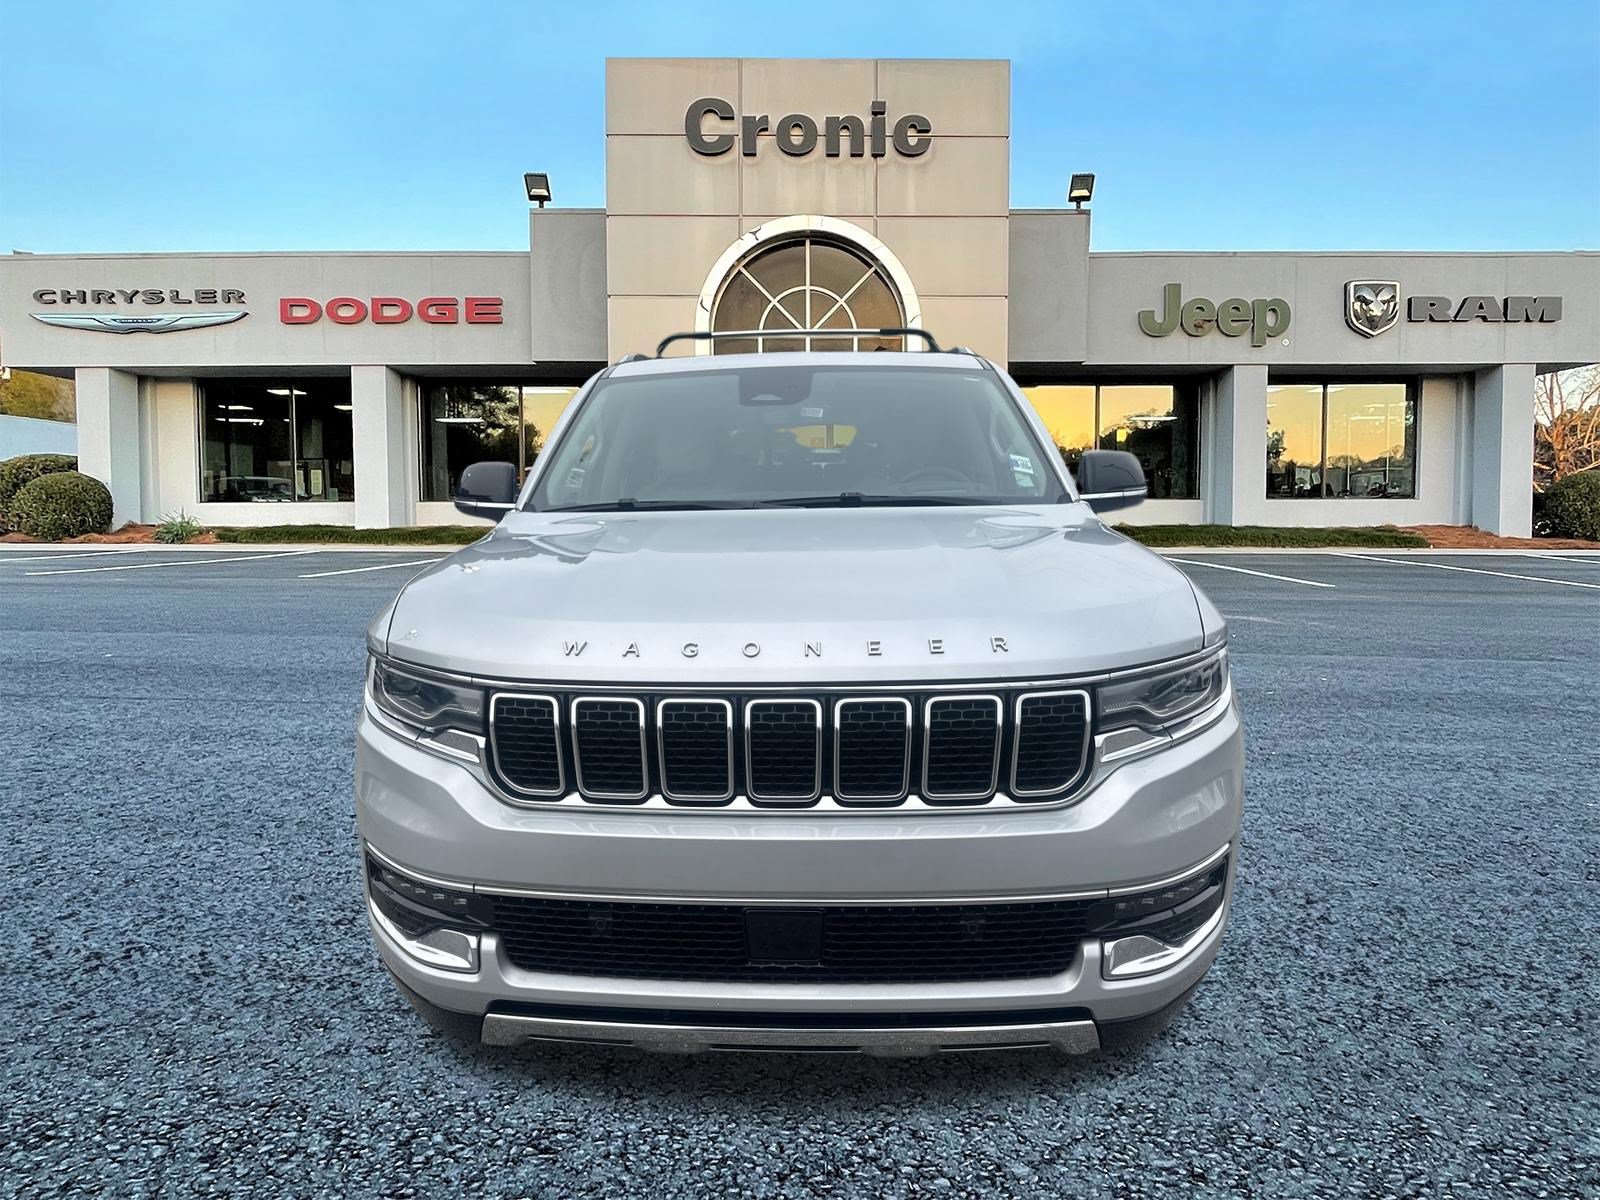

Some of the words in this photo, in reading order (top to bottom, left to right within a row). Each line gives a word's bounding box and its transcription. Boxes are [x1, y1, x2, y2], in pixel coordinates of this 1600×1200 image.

[685, 98, 932, 157] Cronic
[32, 288, 247, 305] CHRYSLER
[1408, 296, 1562, 322] RAM
[279, 297, 504, 325] DODGE
[1138, 283, 1291, 347] Jeep
[563, 636, 1009, 658] WAGONEER
